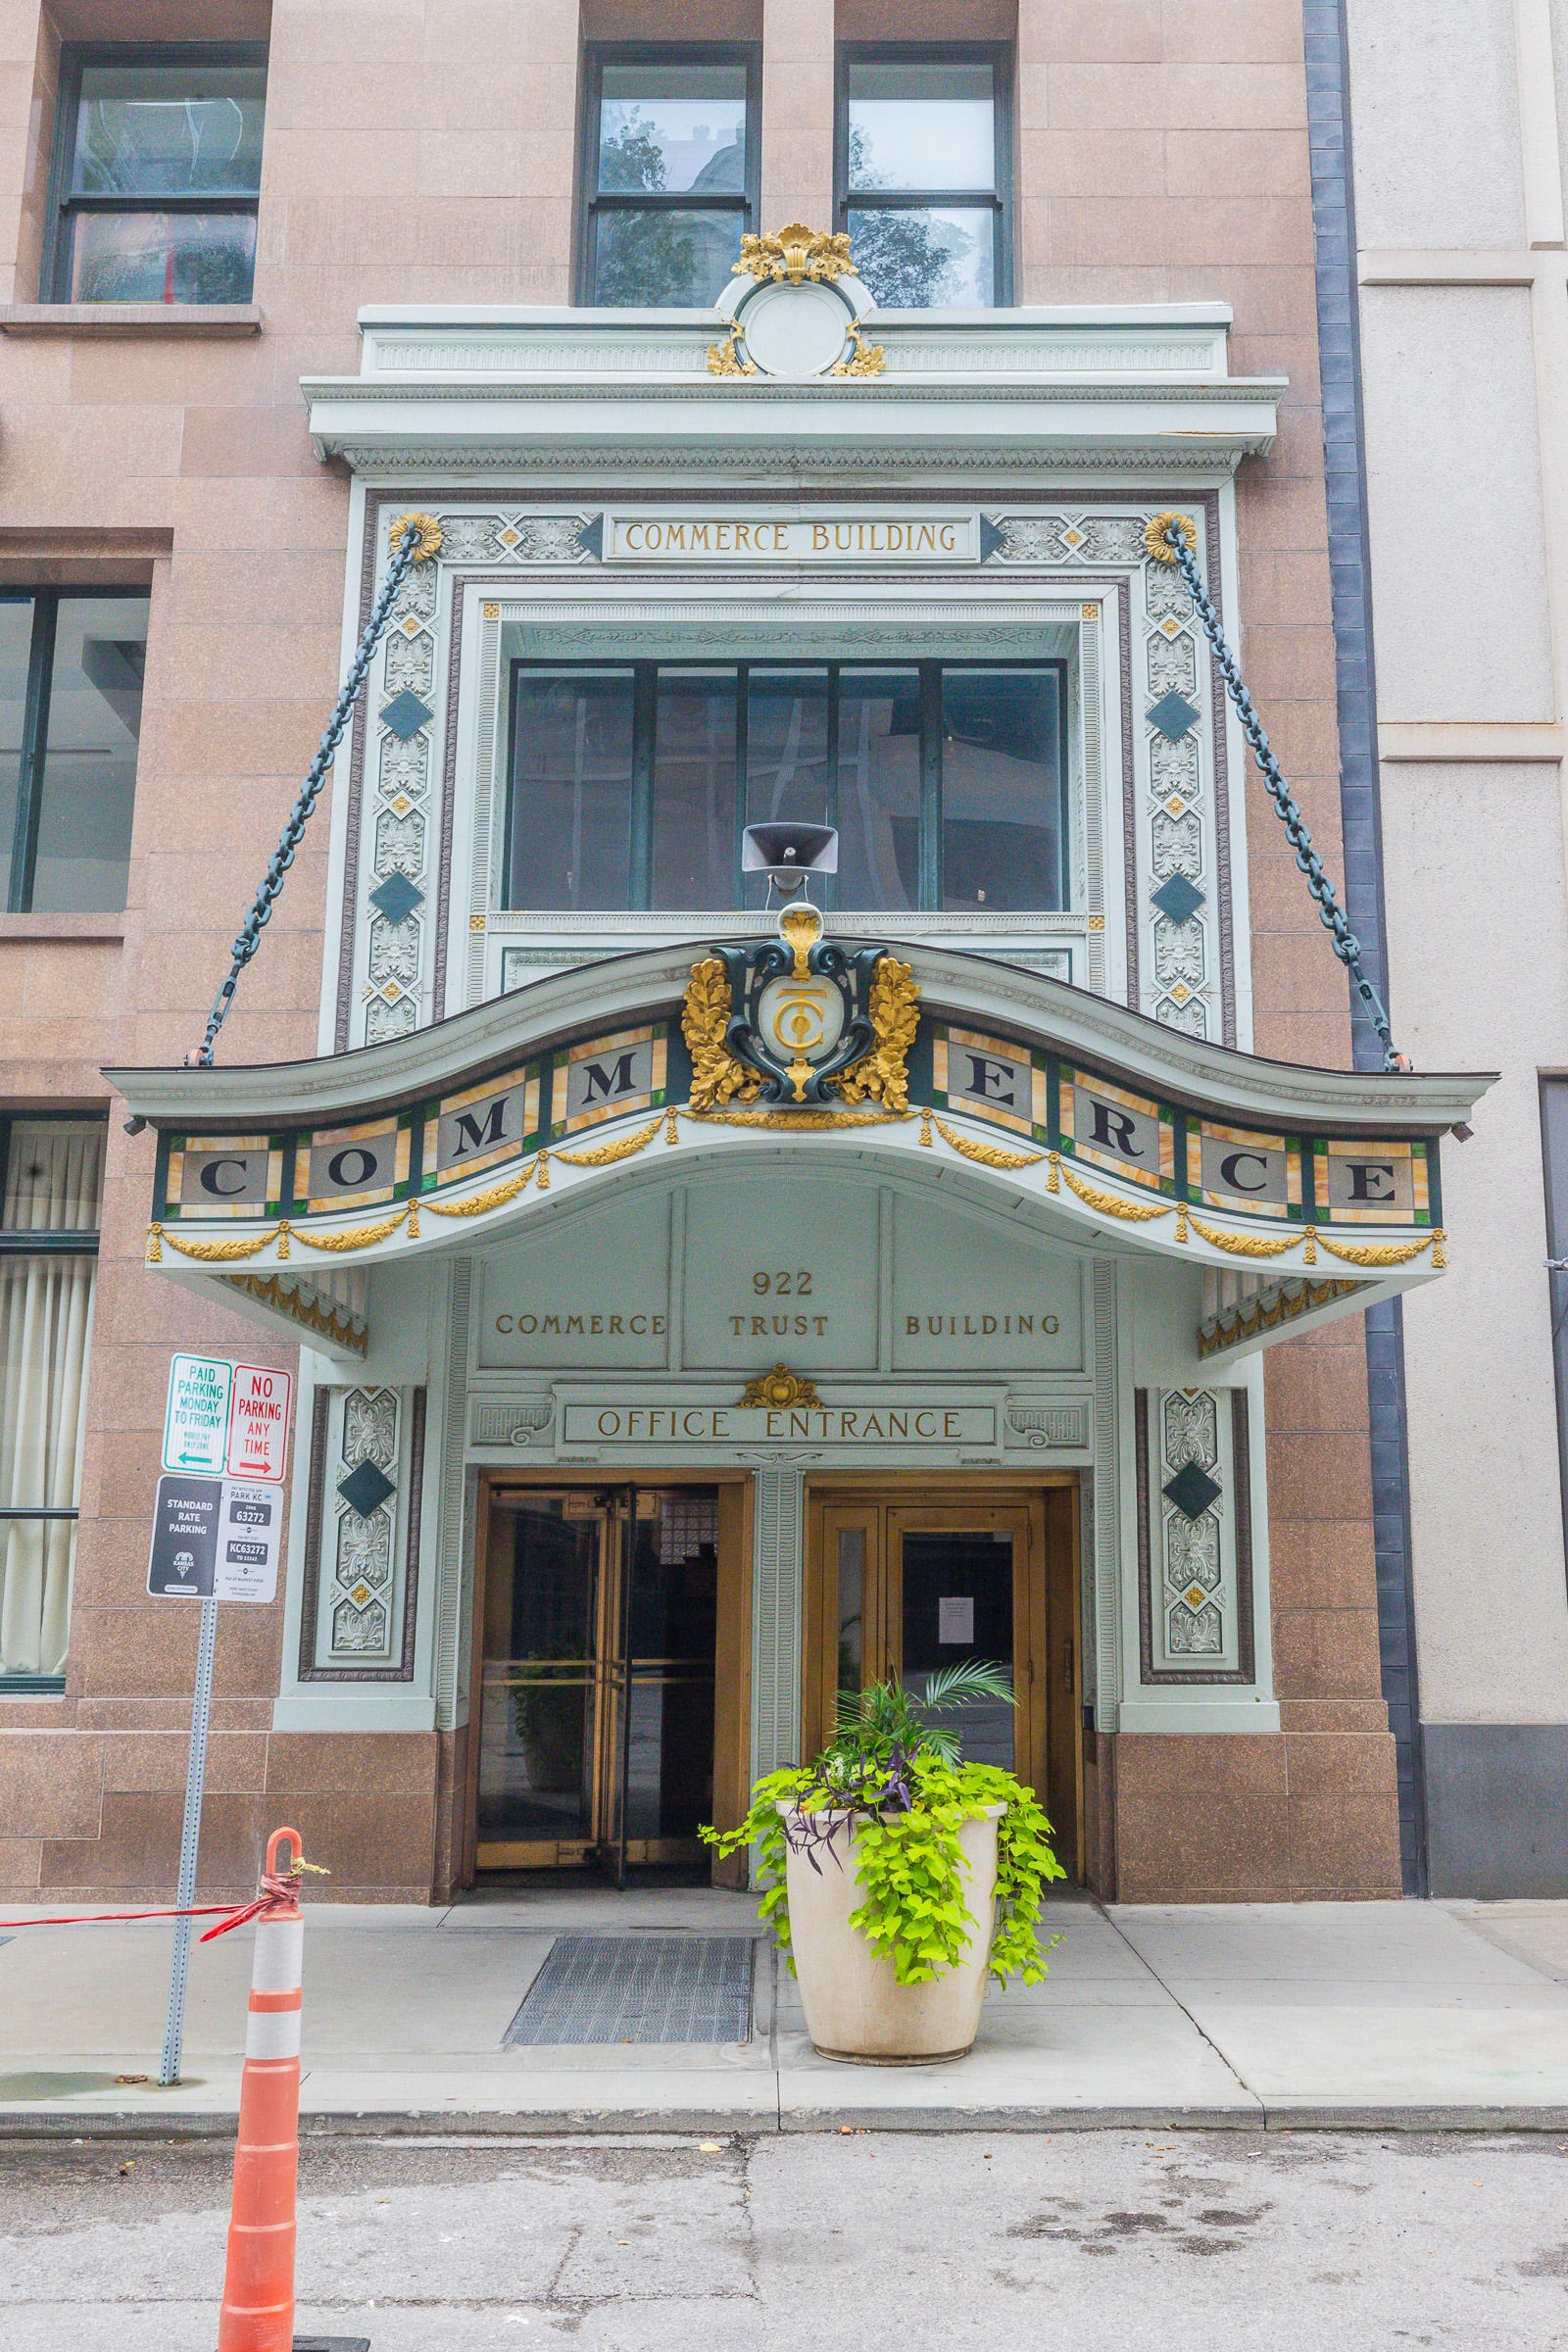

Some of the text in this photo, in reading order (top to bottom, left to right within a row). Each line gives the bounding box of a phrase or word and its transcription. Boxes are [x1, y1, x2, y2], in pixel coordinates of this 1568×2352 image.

[625, 523, 956, 552] COMMERCE BUILDING
[752, 1271, 813, 1296] 922
[495, 1313, 1060, 1337] COMMERCE TRUST BUILDING
[189, 1365, 216, 1383] PAID
[177, 1380, 223, 1399] PARKING
[251, 1375, 273, 1397] NO
[179, 1396, 219, 1413] MONDAY
[238, 1398, 282, 1421] PARKING
[174, 1410, 221, 1428] TO FRIDAY
[597, 1409, 962, 1438] OFFICE ENTRANCE
[247, 1421, 270, 1437] ANY
[244, 1439, 270, 1456] TIME
[230, 1491, 251, 1500] PARK
[167, 1498, 214, 1511] STANDARD
[177, 1512, 201, 1522] RATE
[236, 1510, 265, 1524] 63272
[169, 1523, 208, 1535] PARKING
[229, 1543, 266, 1555] KC63272
